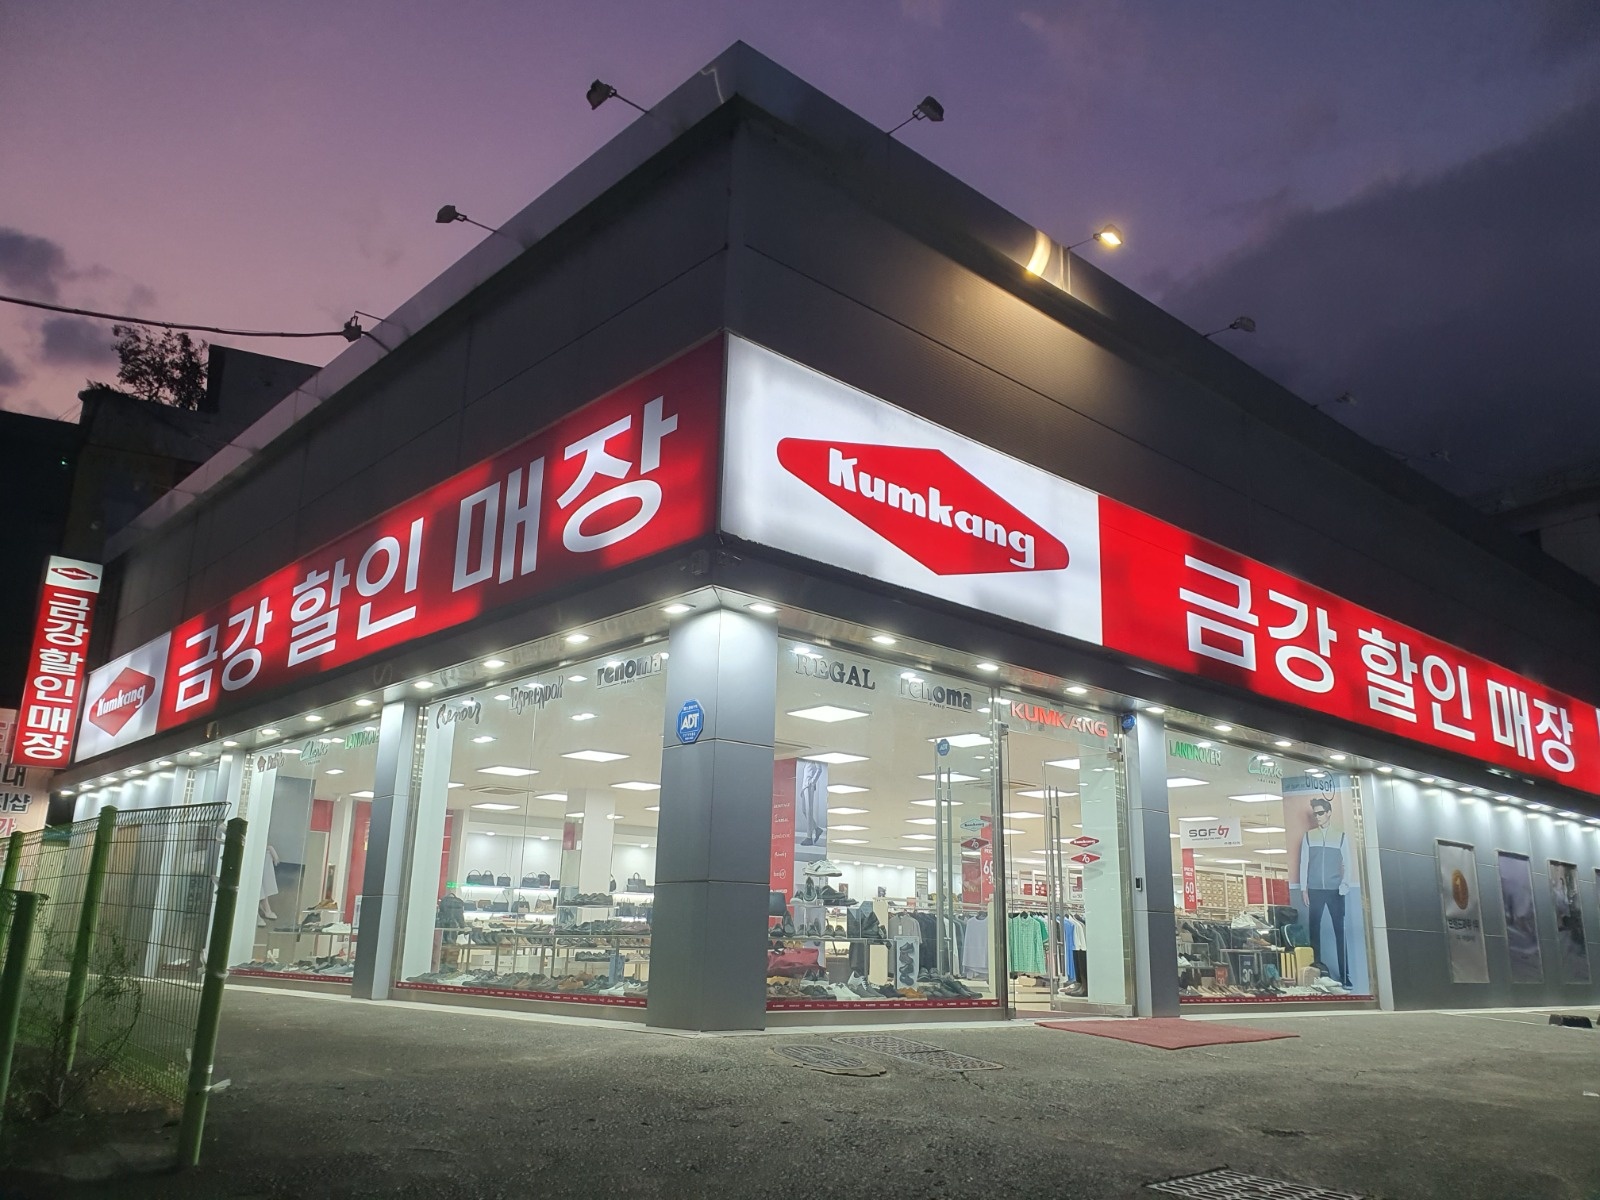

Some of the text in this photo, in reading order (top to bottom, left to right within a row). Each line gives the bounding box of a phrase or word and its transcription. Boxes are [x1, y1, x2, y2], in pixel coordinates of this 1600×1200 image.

[828, 447, 1035, 569] Kumkang
[175, 395, 679, 713] 금강 할인 매장
[22, 592, 91, 760] 금강 할인 매장
[597, 652, 662, 686] renoma
[795, 654, 876, 690] REGAL
[1179, 554, 1576, 773] 금강 할인 매장
[96, 684, 146, 717] Kumkang
[900, 678, 973, 709] renoma
[680, 712, 700, 730] ADT
[1010, 701, 1109, 738] KUMKANG
[1169, 739, 1222, 767] LANDROVER
